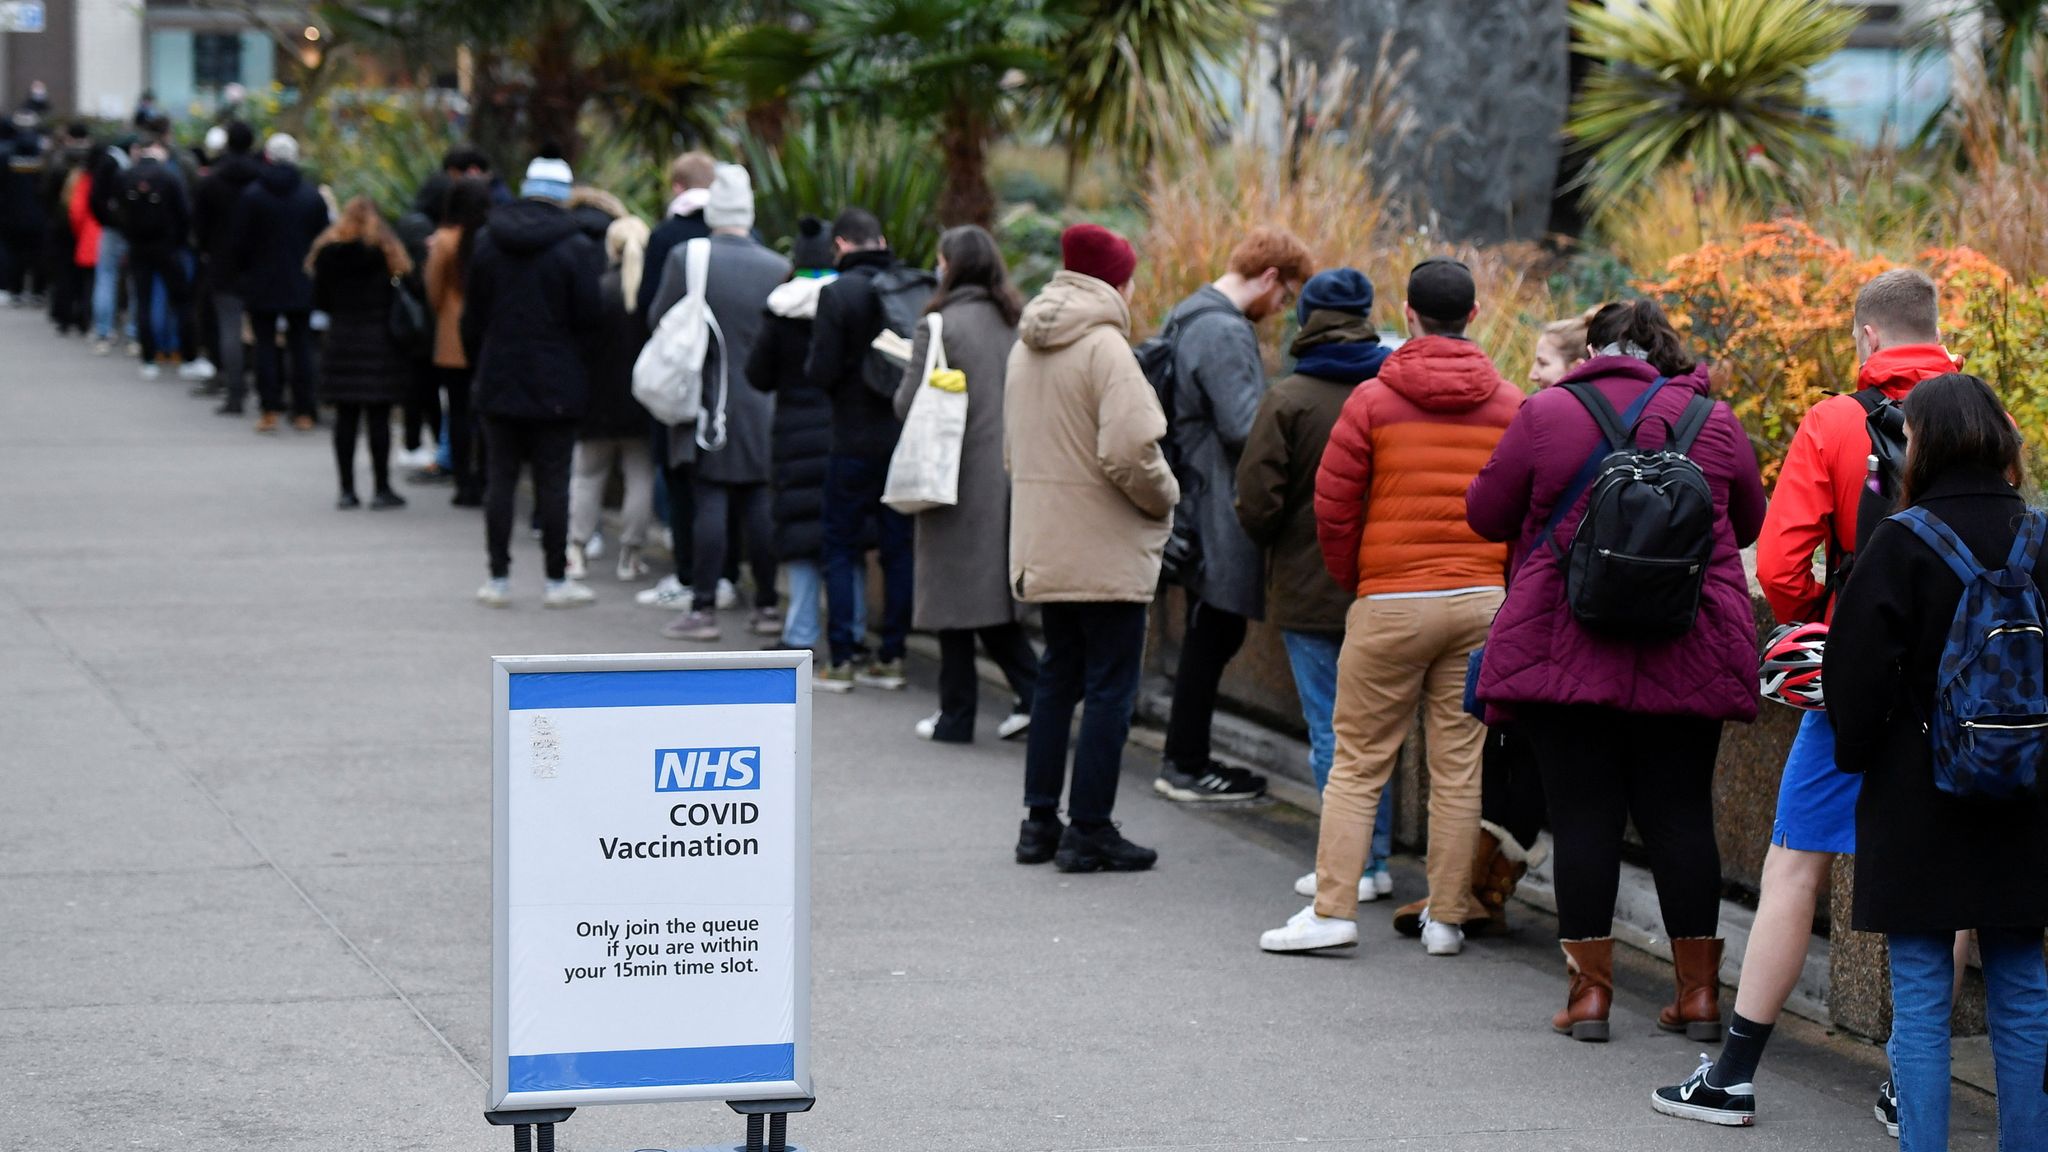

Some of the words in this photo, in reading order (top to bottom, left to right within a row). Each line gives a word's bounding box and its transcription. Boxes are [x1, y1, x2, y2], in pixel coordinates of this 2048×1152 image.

[657, 750, 757, 789] NHS
[669, 802, 759, 827] COVID
[599, 833, 759, 860] Vaccination
[576, 919, 620, 941] Only
[624, 918, 660, 940] join
[665, 917, 696, 935] the
[702, 919, 759, 937] queue
[607, 940, 620, 957] if
[625, 943, 659, 961] you
[665, 942, 695, 955] are
[700, 935, 759, 954] within
[564, 966, 607, 984] your
[613, 960, 667, 978] 15min
[673, 958, 715, 976] time
[720, 956, 759, 974] slot.
